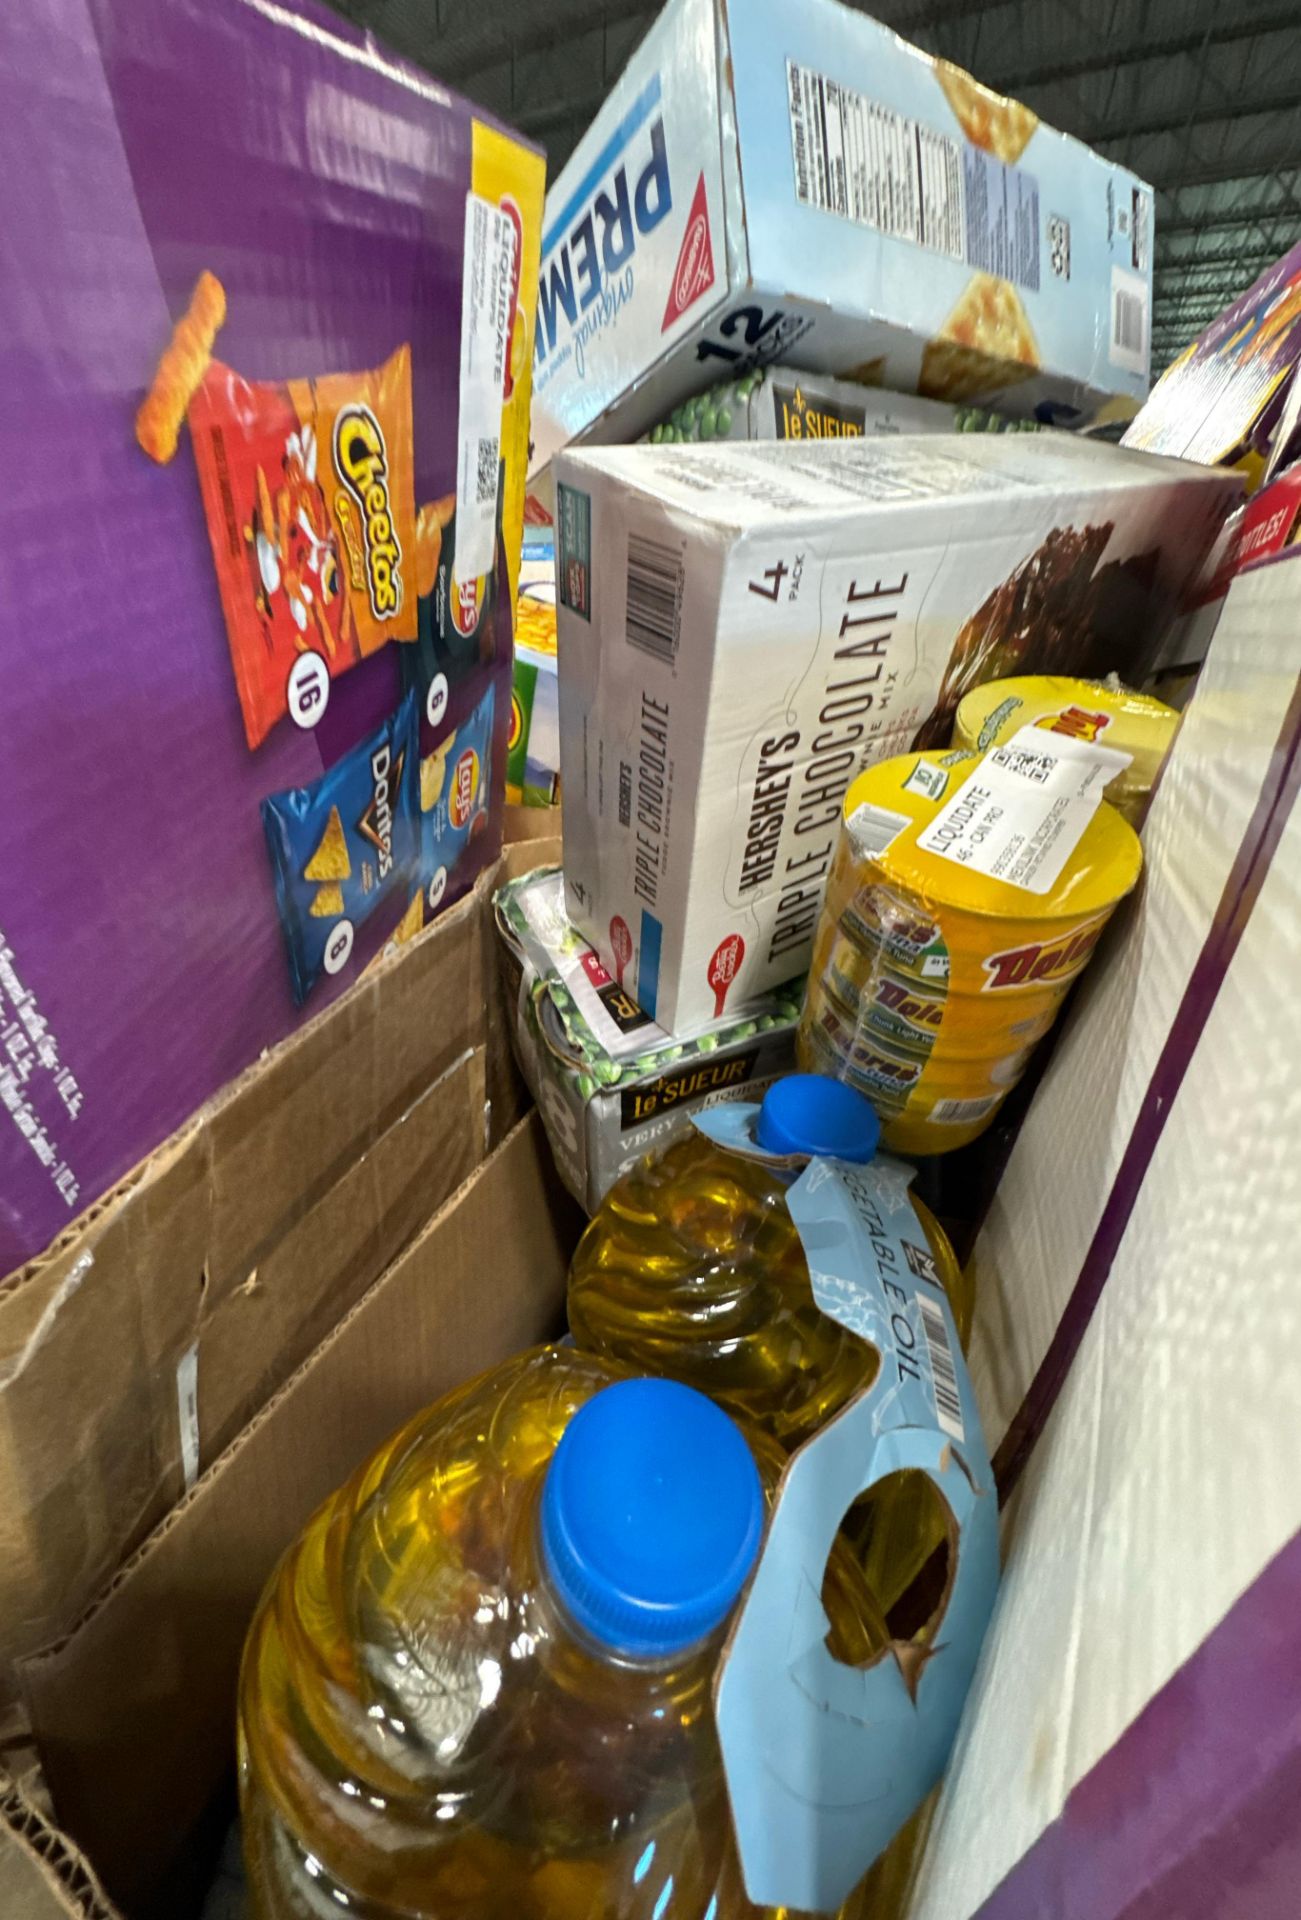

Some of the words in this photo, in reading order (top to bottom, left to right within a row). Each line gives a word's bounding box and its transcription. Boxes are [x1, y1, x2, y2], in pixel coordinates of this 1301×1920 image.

[696, 304, 784, 362] 12
[338, 413, 399, 612] Cheetos
[748, 560, 788, 603] 4
[788, 553, 806, 602] PACK
[296, 670, 322, 713] 16
[793, 572, 909, 837] CHOCOLATE
[878, 669, 898, 711] MIX
[618, 760, 633, 829] HERSHEY'S
[637, 690, 669, 835] CHOCOLATE
[371, 744, 394, 879] Doritos
[738, 730, 801, 893] HERSHEY'S
[927, 784, 992, 853] LIQUIDATE
[570, 879, 586, 905] 4
[634, 831, 660, 907] TRIPLE
[768, 840, 833, 964] TRIPLE
[662, 1059, 747, 1104] SUEUR
[620, 1116, 677, 1151] VERY
[890, 1313, 921, 1384] OIL
